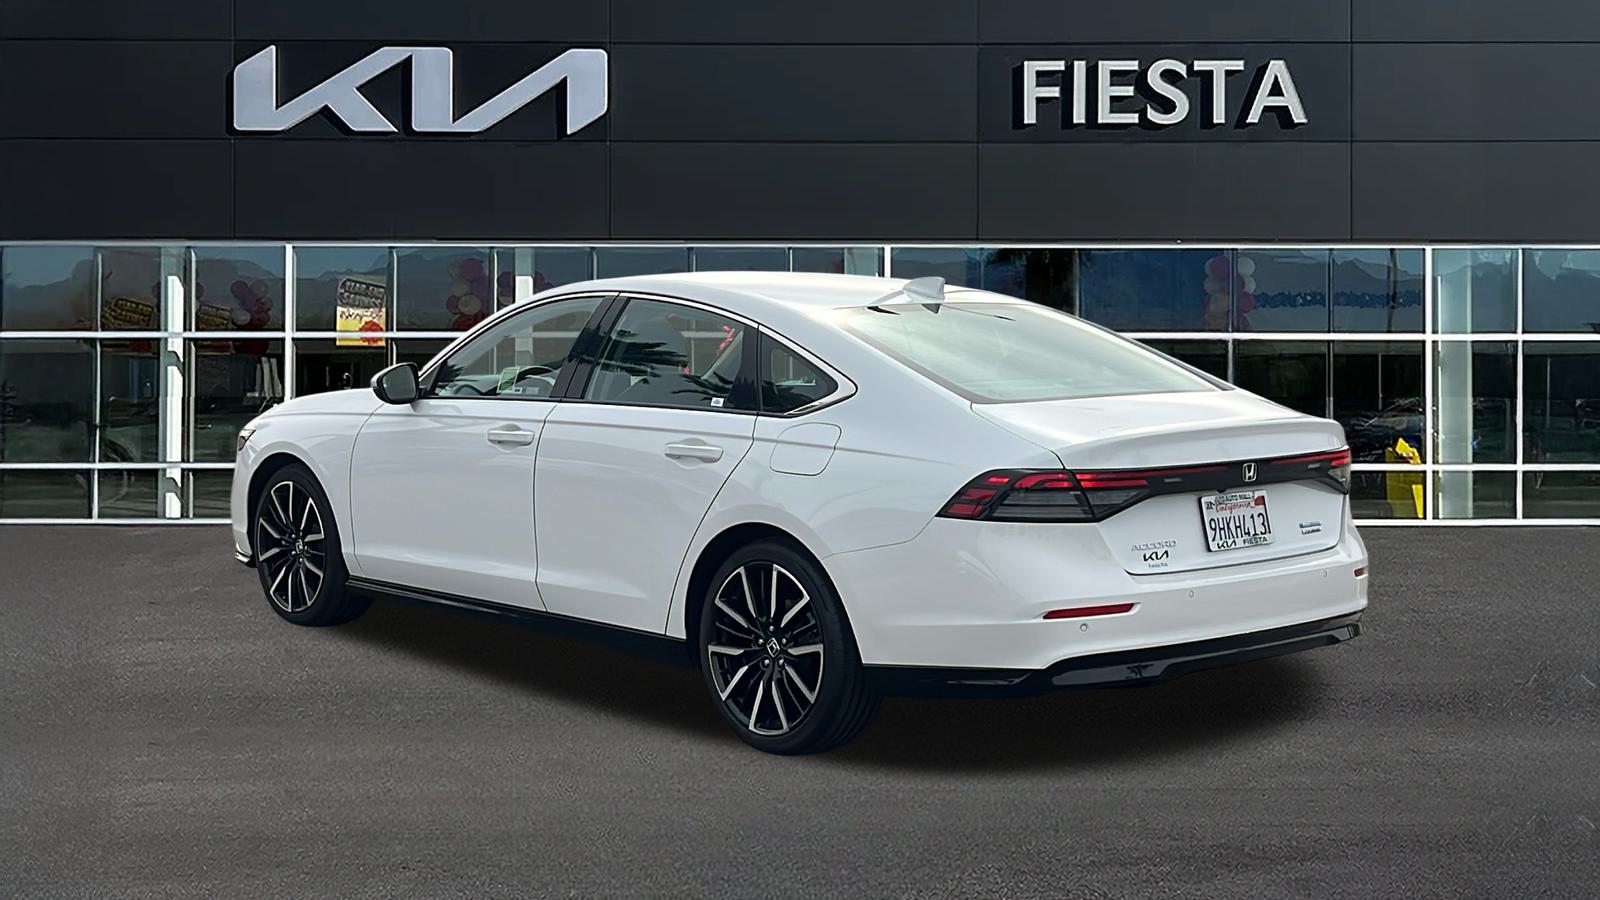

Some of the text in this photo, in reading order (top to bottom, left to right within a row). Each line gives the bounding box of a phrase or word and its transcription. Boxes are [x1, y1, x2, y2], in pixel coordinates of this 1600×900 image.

[233, 45, 609, 135] KIA
[1023, 59, 1308, 125] FIESTA
[1209, 512, 1267, 542] 9HKH413
[1130, 540, 1177, 552] ACCORD
[1243, 536, 1268, 545] FIESTA
[1143, 549, 1169, 561] KIA
